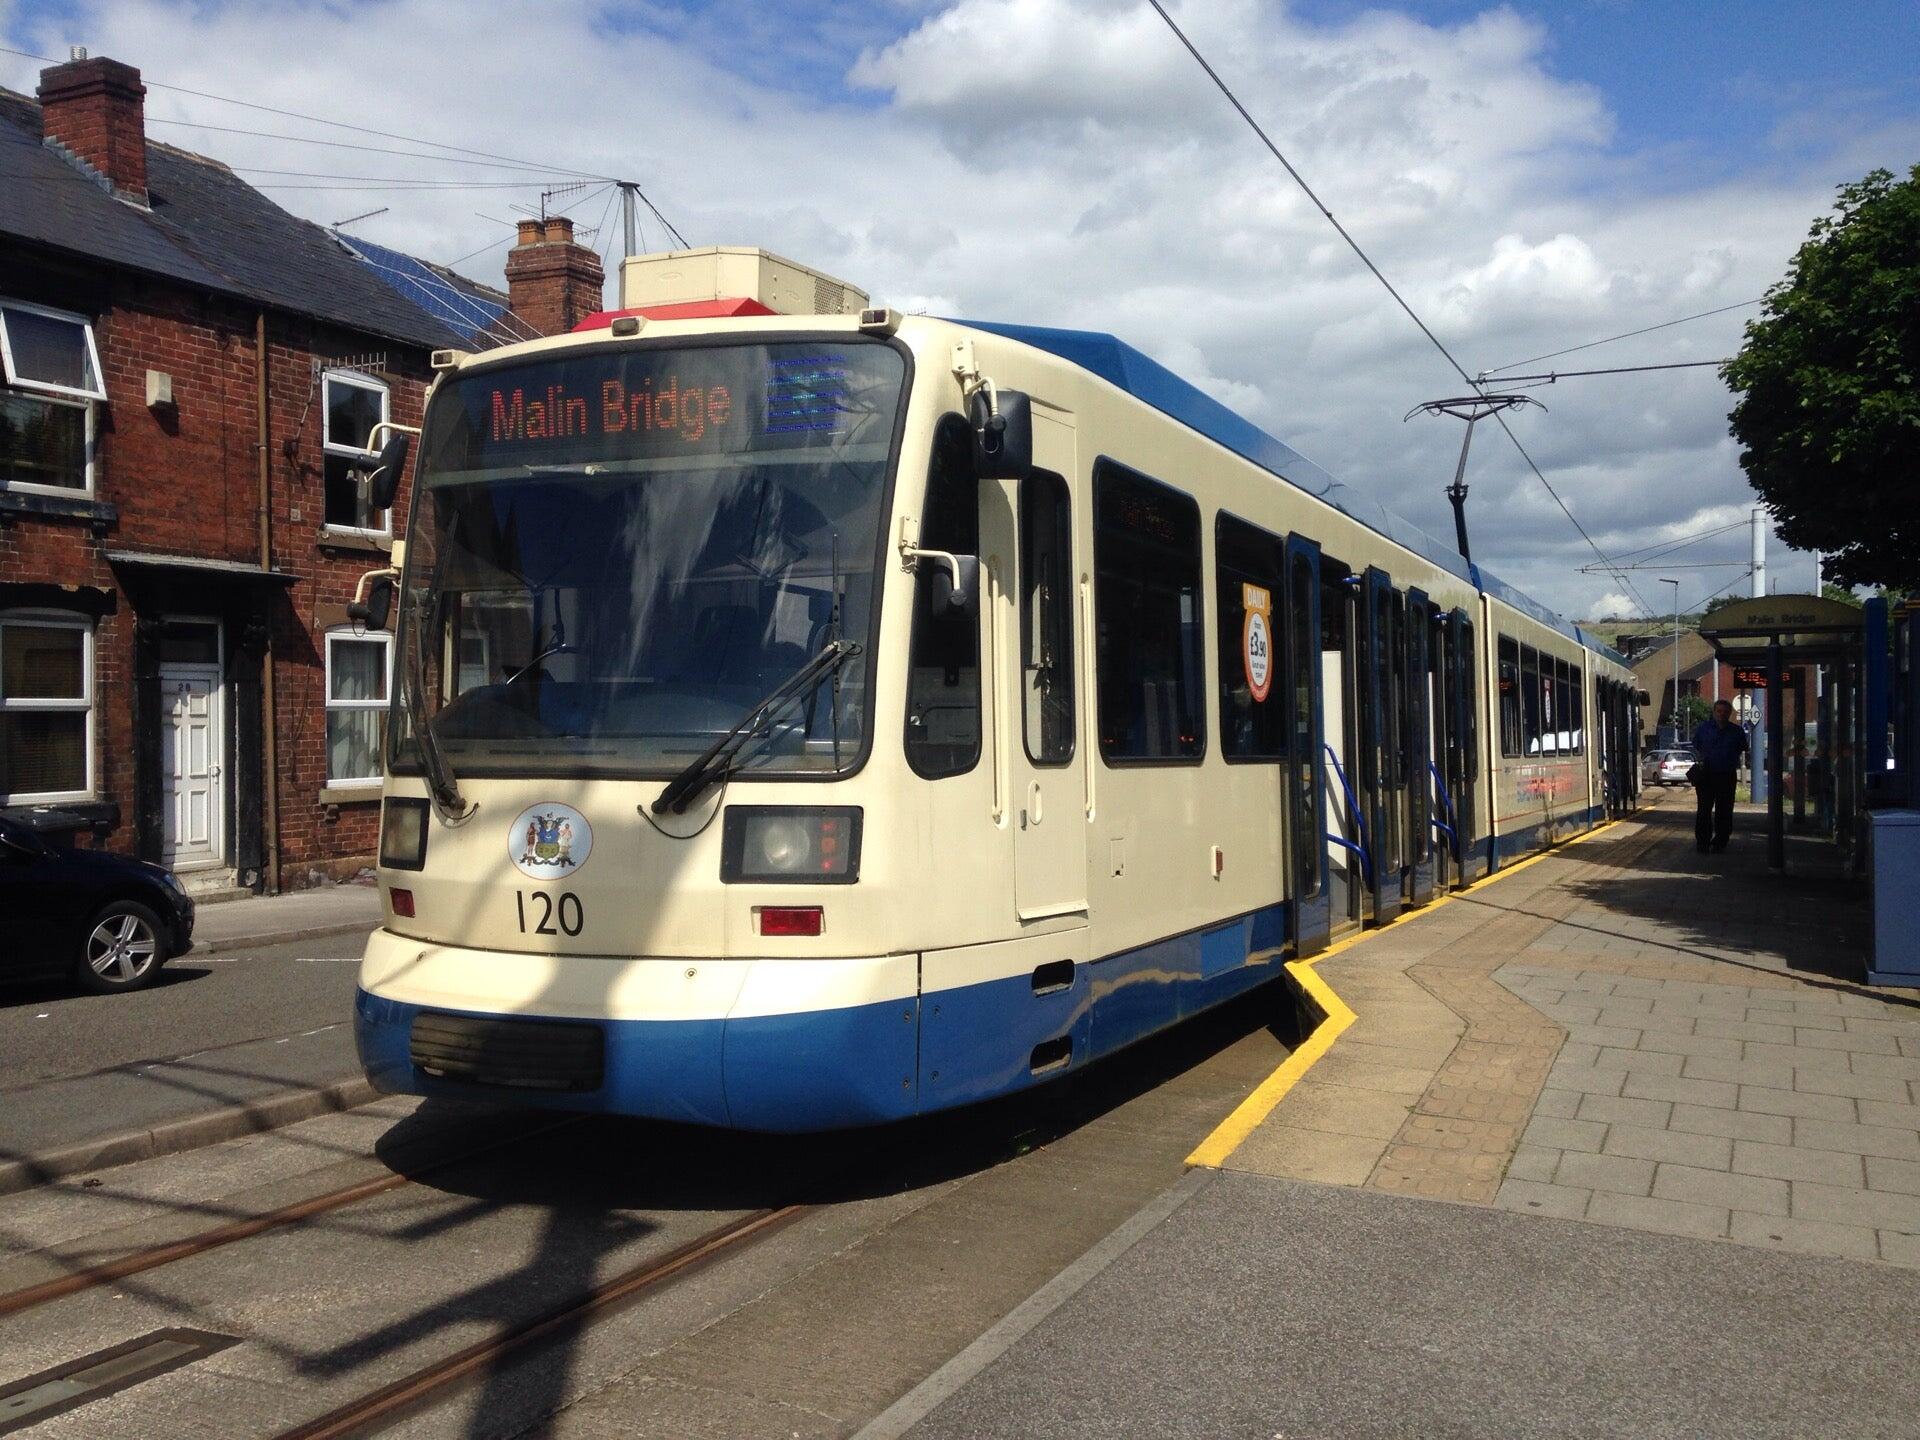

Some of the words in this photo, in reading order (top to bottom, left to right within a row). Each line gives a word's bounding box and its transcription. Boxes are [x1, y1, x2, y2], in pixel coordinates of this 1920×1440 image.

[490, 385, 587, 442] Malin
[602, 375, 732, 442] Bridge
[1247, 588, 1266, 609] DAILY
[516, 890, 584, 937] 120
